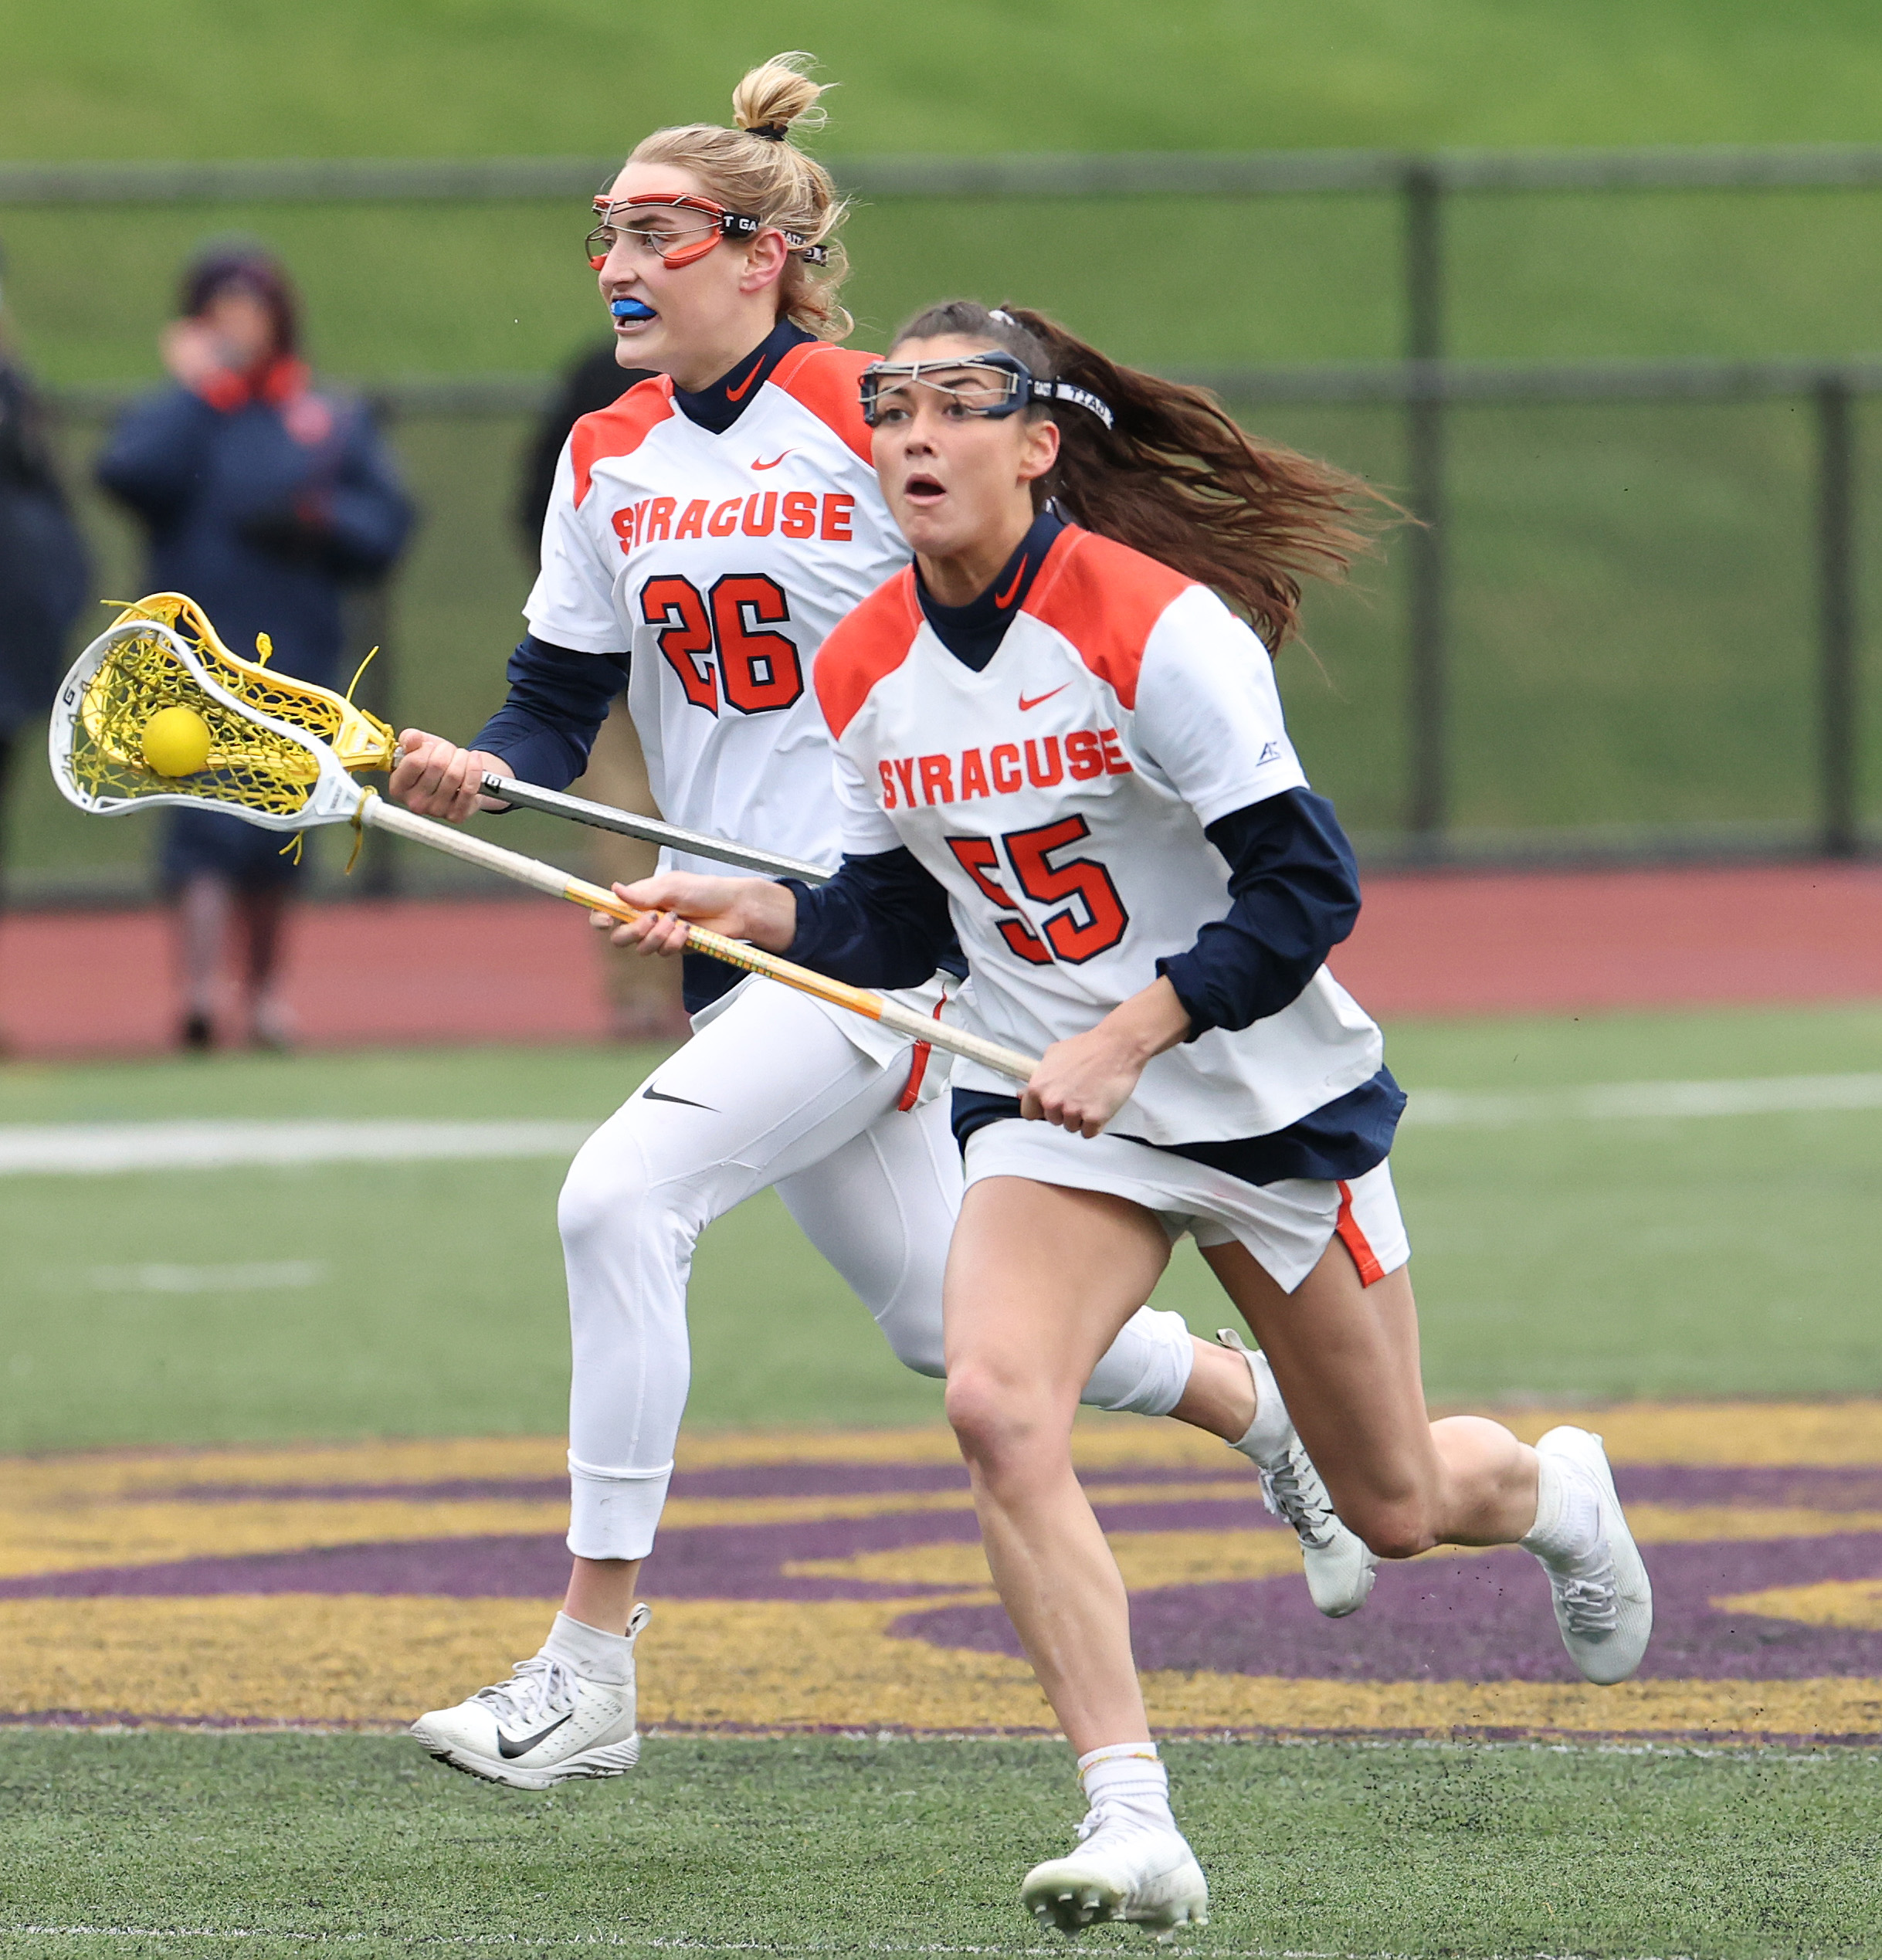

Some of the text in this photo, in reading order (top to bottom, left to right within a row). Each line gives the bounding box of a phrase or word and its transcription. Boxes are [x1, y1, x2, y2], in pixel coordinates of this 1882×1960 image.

[612, 491, 855, 556] SYRACUSE
[639, 572, 805, 719] 26
[878, 727, 1133, 809] SYRACUSE
[946, 813, 1130, 965] 55
